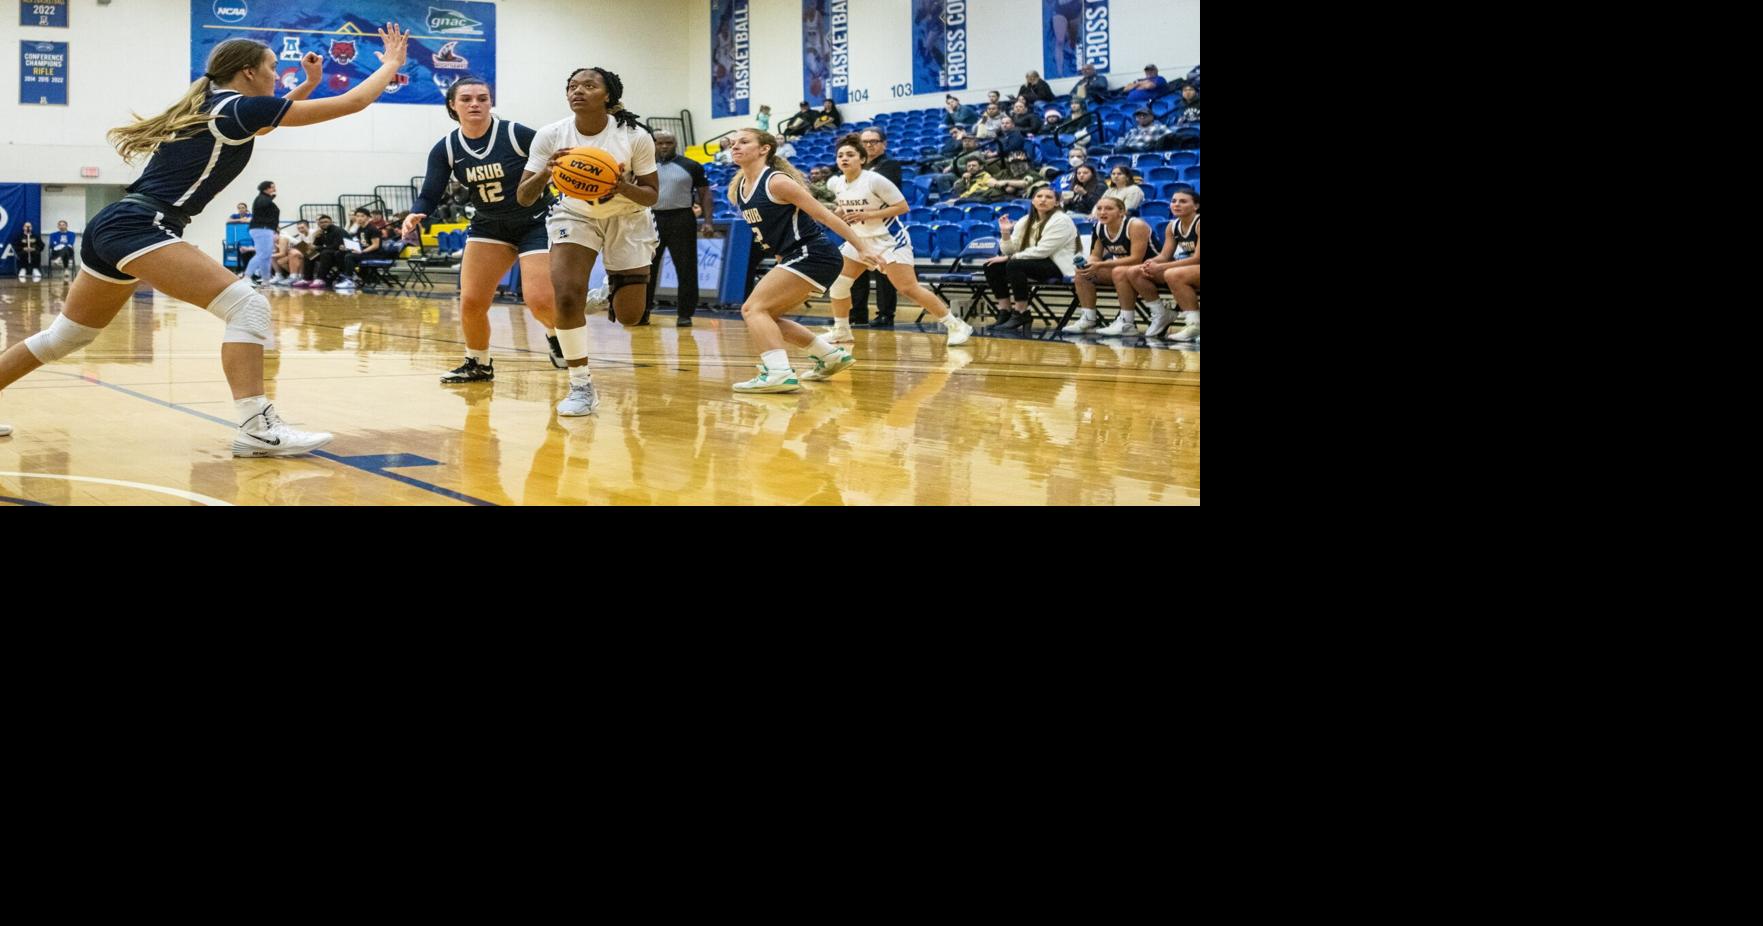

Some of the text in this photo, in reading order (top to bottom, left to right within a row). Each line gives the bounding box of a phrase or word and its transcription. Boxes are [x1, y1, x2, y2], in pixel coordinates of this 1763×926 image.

[33, 4, 55, 15] 2022
[217, 7, 246, 16] NCAA
[431, 16, 466, 28] gnac
[832, 0, 848, 87] BASKETBA
[947, 0, 966, 87] CROSS CO
[1086, 6, 1108, 70] CROSS
[24, 53, 64, 61] CONFERENCE
[735, 4, 749, 99] BASKETBALL
[25, 60, 62, 68] CHAMPIONS
[32, 67, 54, 76] RIFLE
[849, 89, 869, 102] 104
[891, 83, 913, 98] 103
[466, 162, 505, 182] MSUB
[570, 160, 603, 176] NCAA
[559, 172, 599, 192] Wilson
[477, 181, 505, 203] 12
